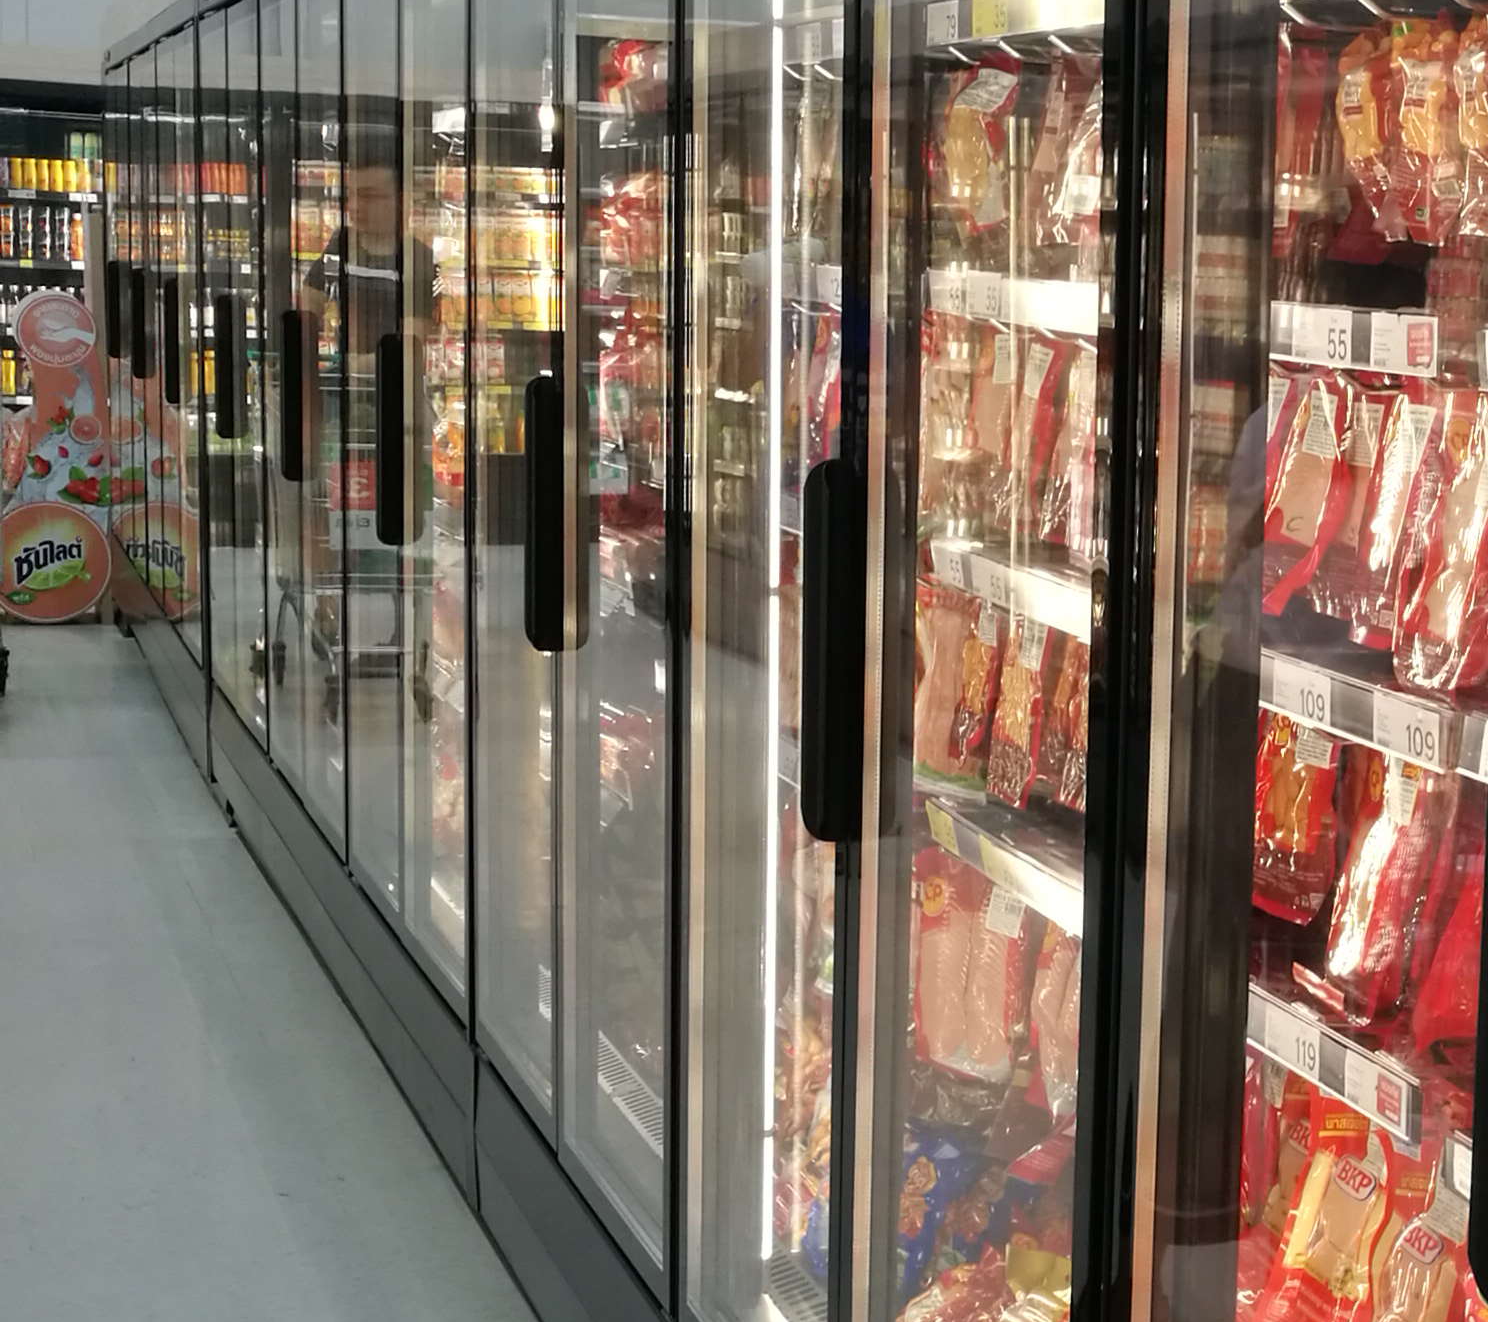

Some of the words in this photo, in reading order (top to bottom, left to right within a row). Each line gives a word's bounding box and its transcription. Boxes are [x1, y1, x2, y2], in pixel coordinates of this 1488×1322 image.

[1327, 327, 1348, 361] 55
[1299, 687, 1326, 722] 109
[1406, 726, 1436, 762] 109
[1295, 1036, 1316, 1072] 119
[1337, 1162, 1372, 1193] BKP
